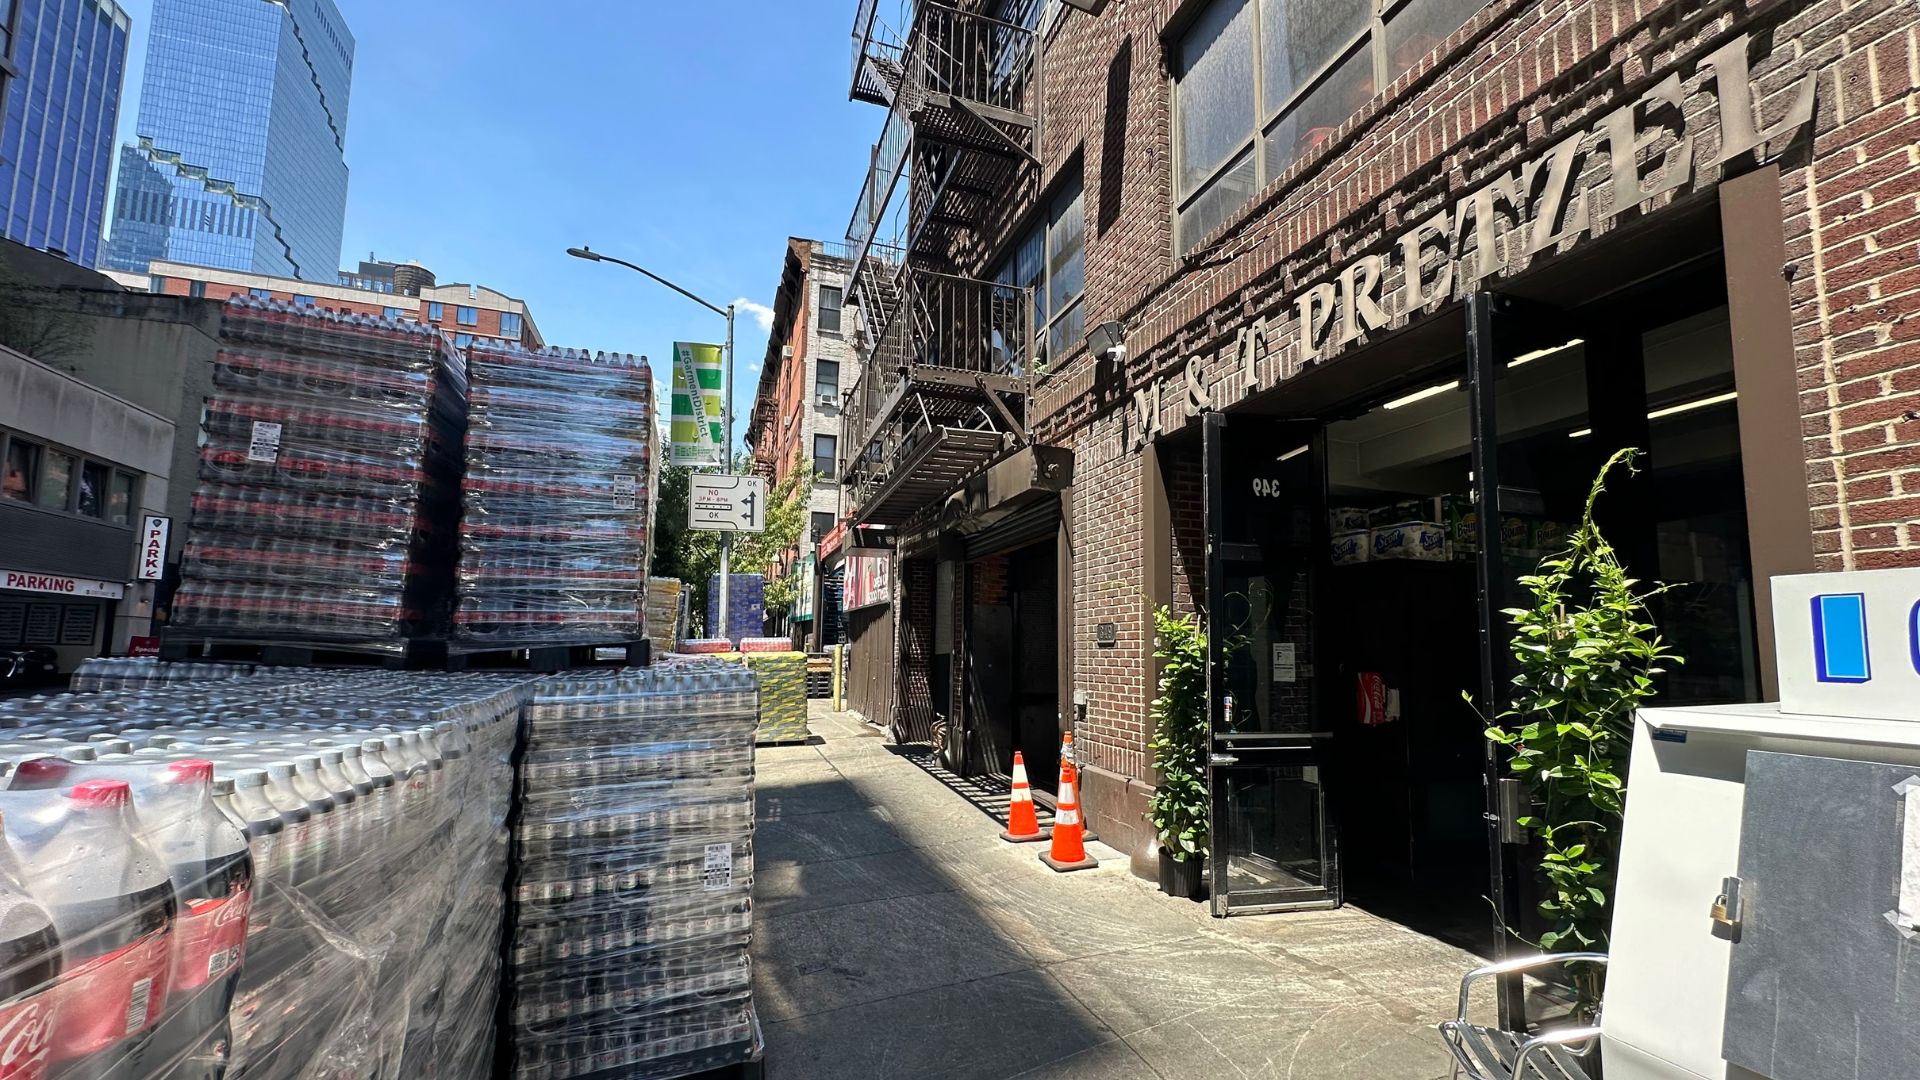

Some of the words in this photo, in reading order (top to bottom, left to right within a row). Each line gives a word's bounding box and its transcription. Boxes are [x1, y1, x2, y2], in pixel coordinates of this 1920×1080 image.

[1134, 375, 1164, 442] M
[1185, 355, 1213, 417] &
[1237, 316, 1268, 390] T
[1294, 33, 1818, 366] PRETZEL
[681, 349, 709, 438] #GarmentDistrict
[708, 511, 719, 519] OK
[145, 529, 161, 568] PARK
[7, 573, 75, 592] PARKING
